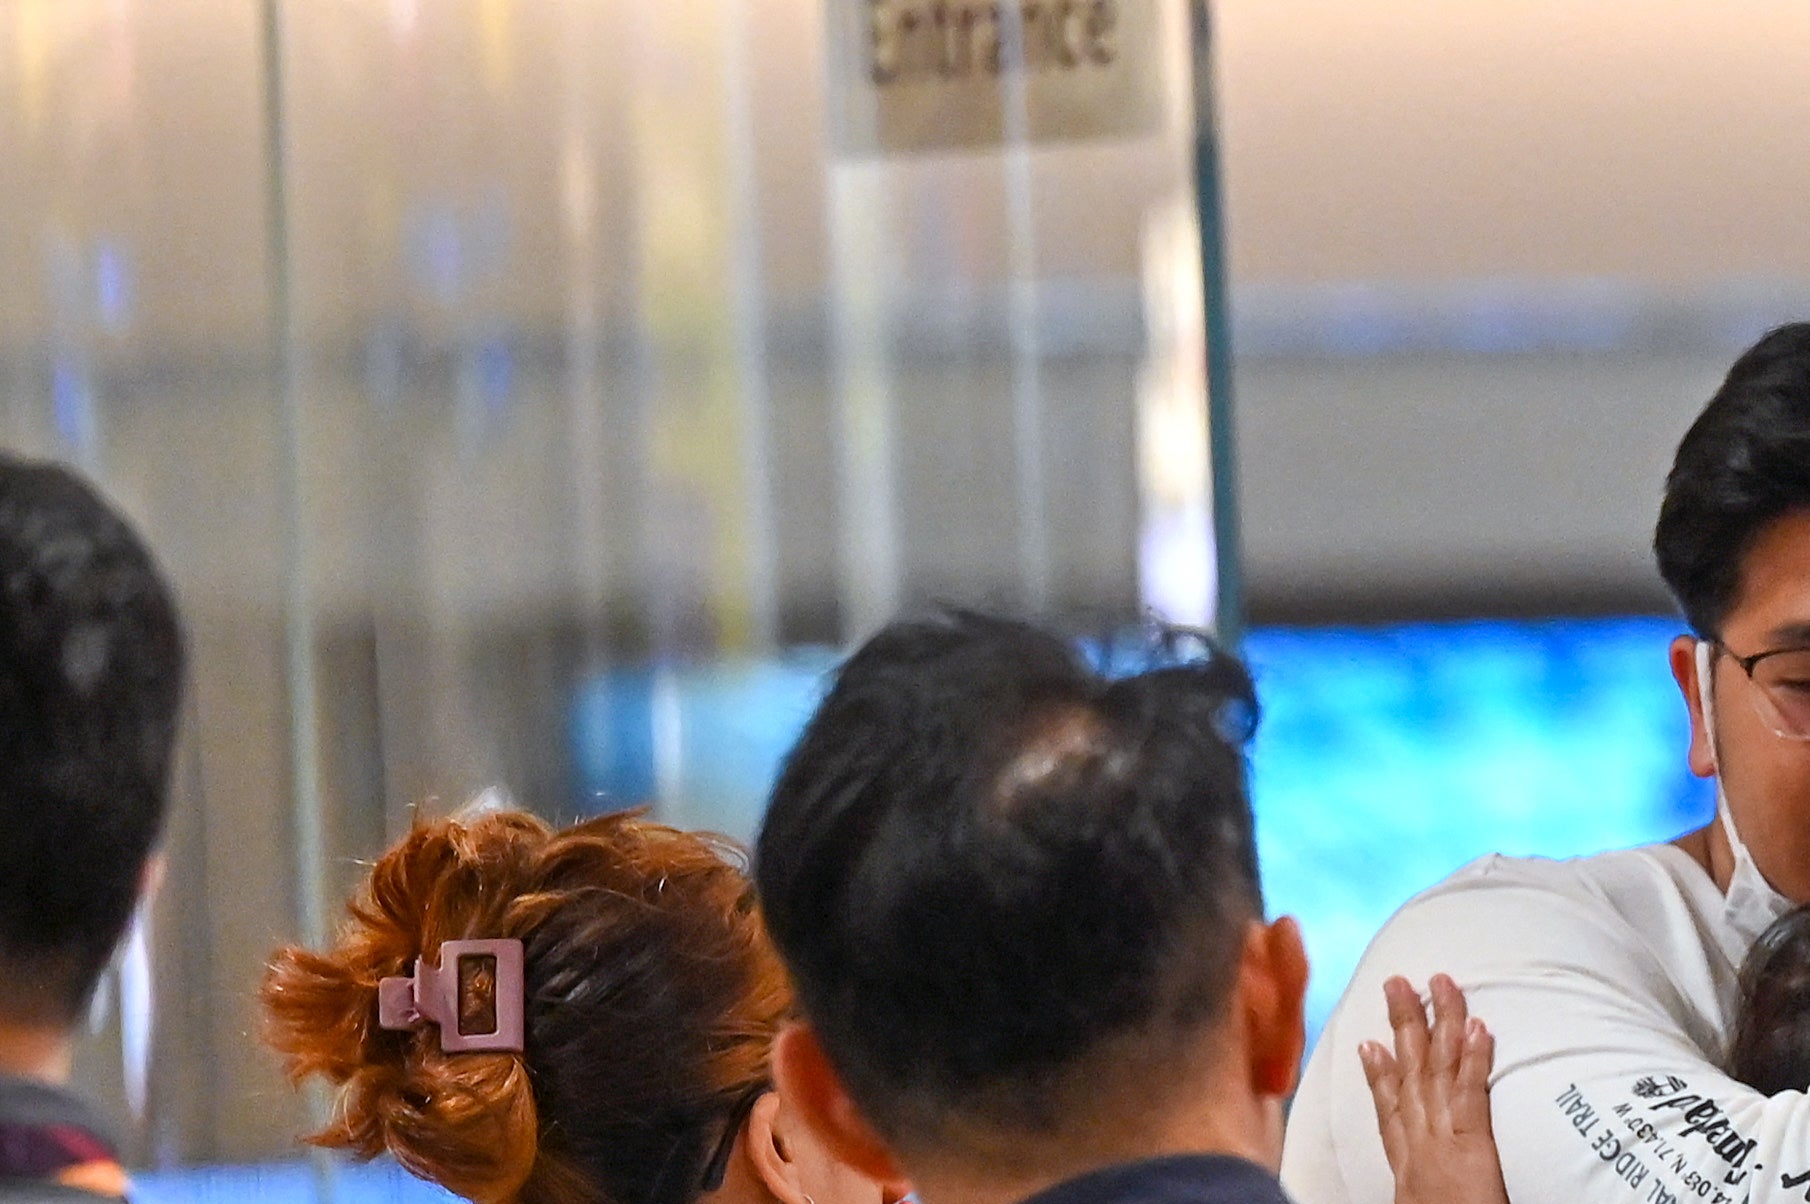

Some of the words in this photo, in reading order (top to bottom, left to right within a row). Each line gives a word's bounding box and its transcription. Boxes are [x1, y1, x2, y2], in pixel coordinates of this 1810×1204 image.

[1555, 1083, 1600, 1138] TRAIL
[1611, 1102, 1633, 1118] W
[1591, 1129, 1650, 1190] RIDGE
